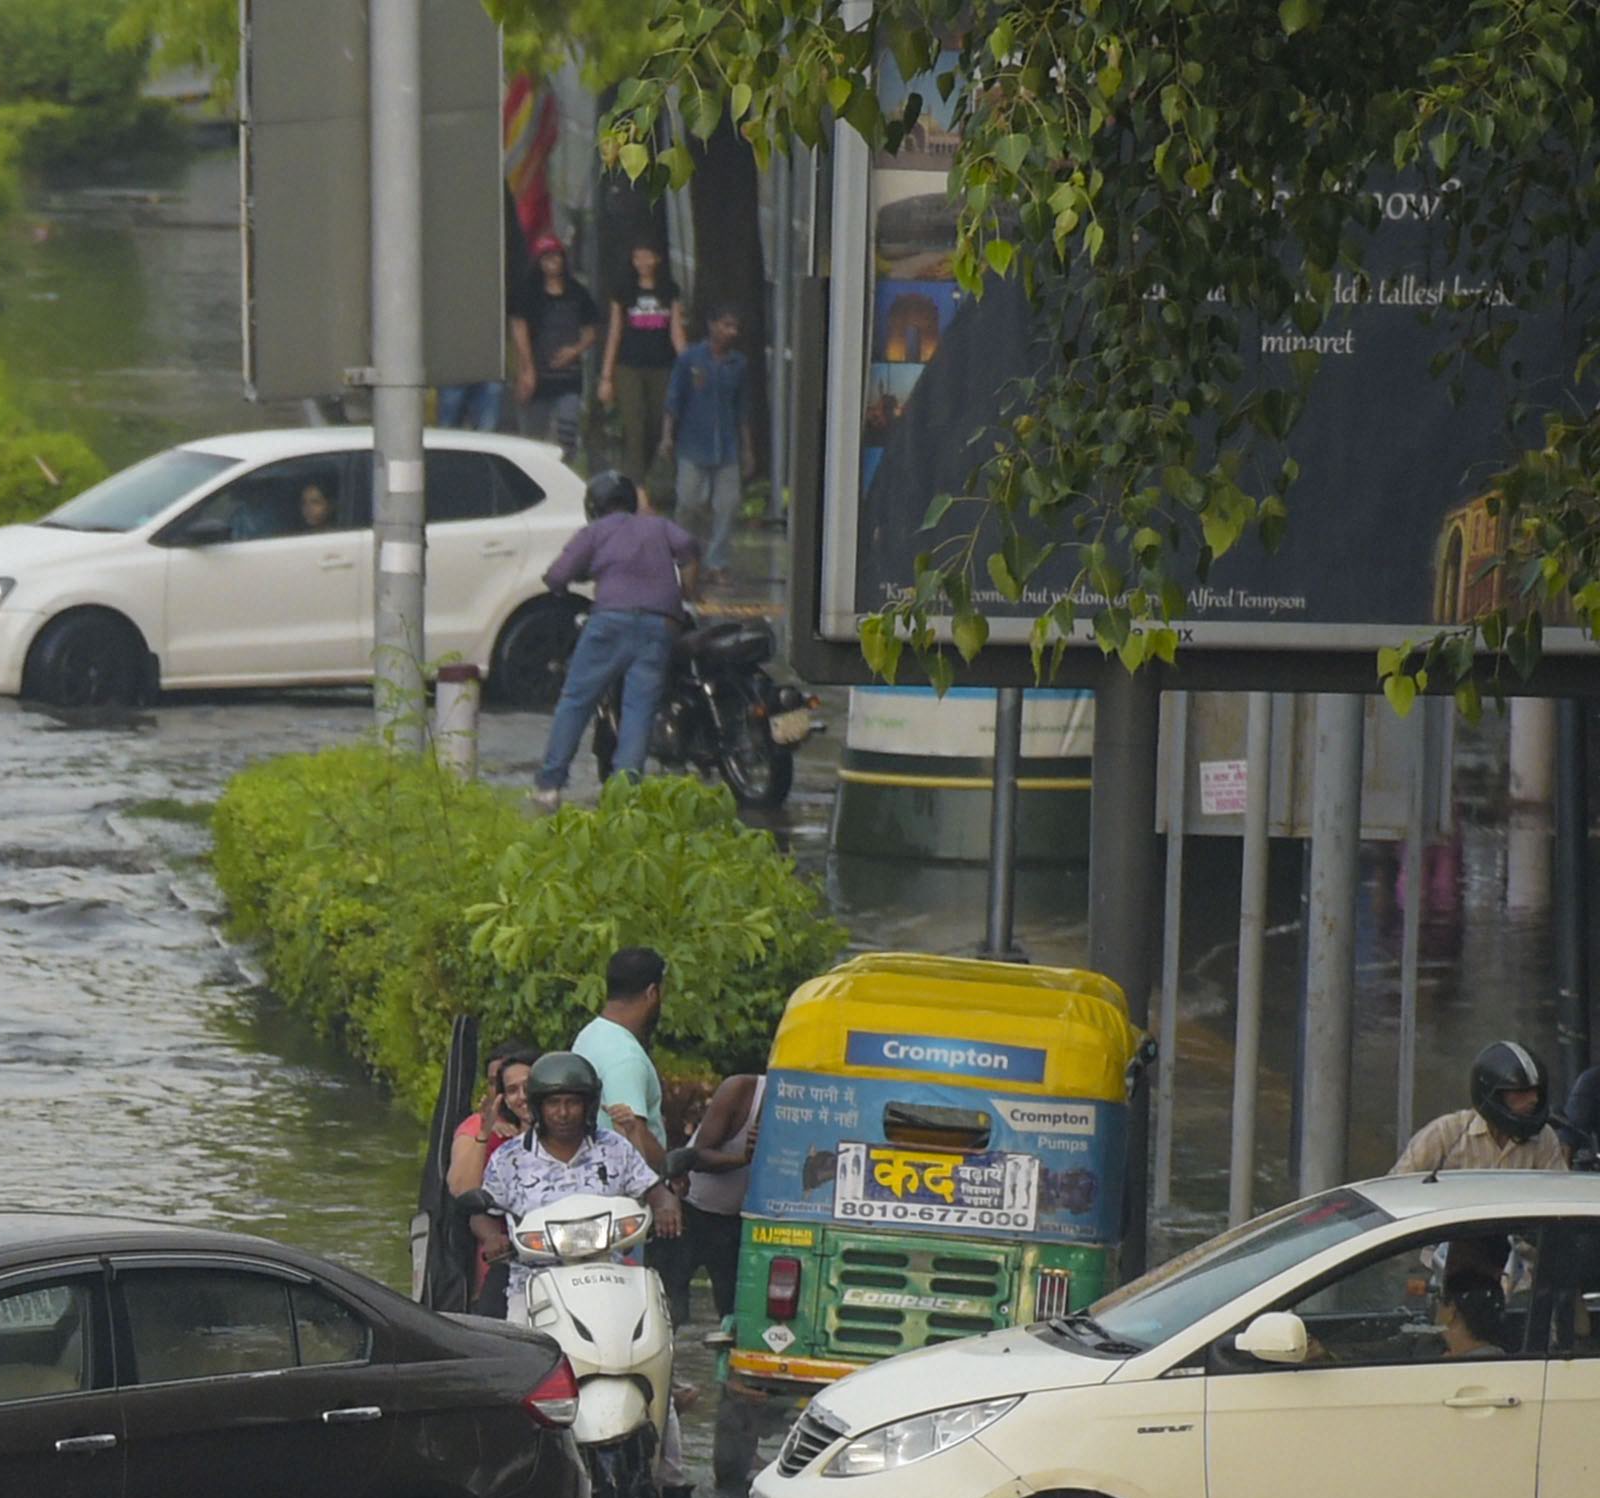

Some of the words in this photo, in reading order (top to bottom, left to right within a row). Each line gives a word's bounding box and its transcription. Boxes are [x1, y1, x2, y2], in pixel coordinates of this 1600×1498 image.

[1379, 274, 1445, 304] tallest
[1261, 327, 1356, 354] minaret
[1188, 588, 1234, 613] Alfred
[1237, 590, 1306, 614] Tennyson
[883, 1040, 1009, 1070] Crompton
[810, 1084, 839, 1104] पानी
[774, 1104, 814, 1125] लाइफ
[1009, 1108, 1090, 1127] Crompton
[1037, 1134, 1089, 1152] Pumps
[870, 1148, 964, 1204] कद
[840, 1202, 1029, 1228] 8010-677-000
[768, 1332, 789, 1343] CNG
